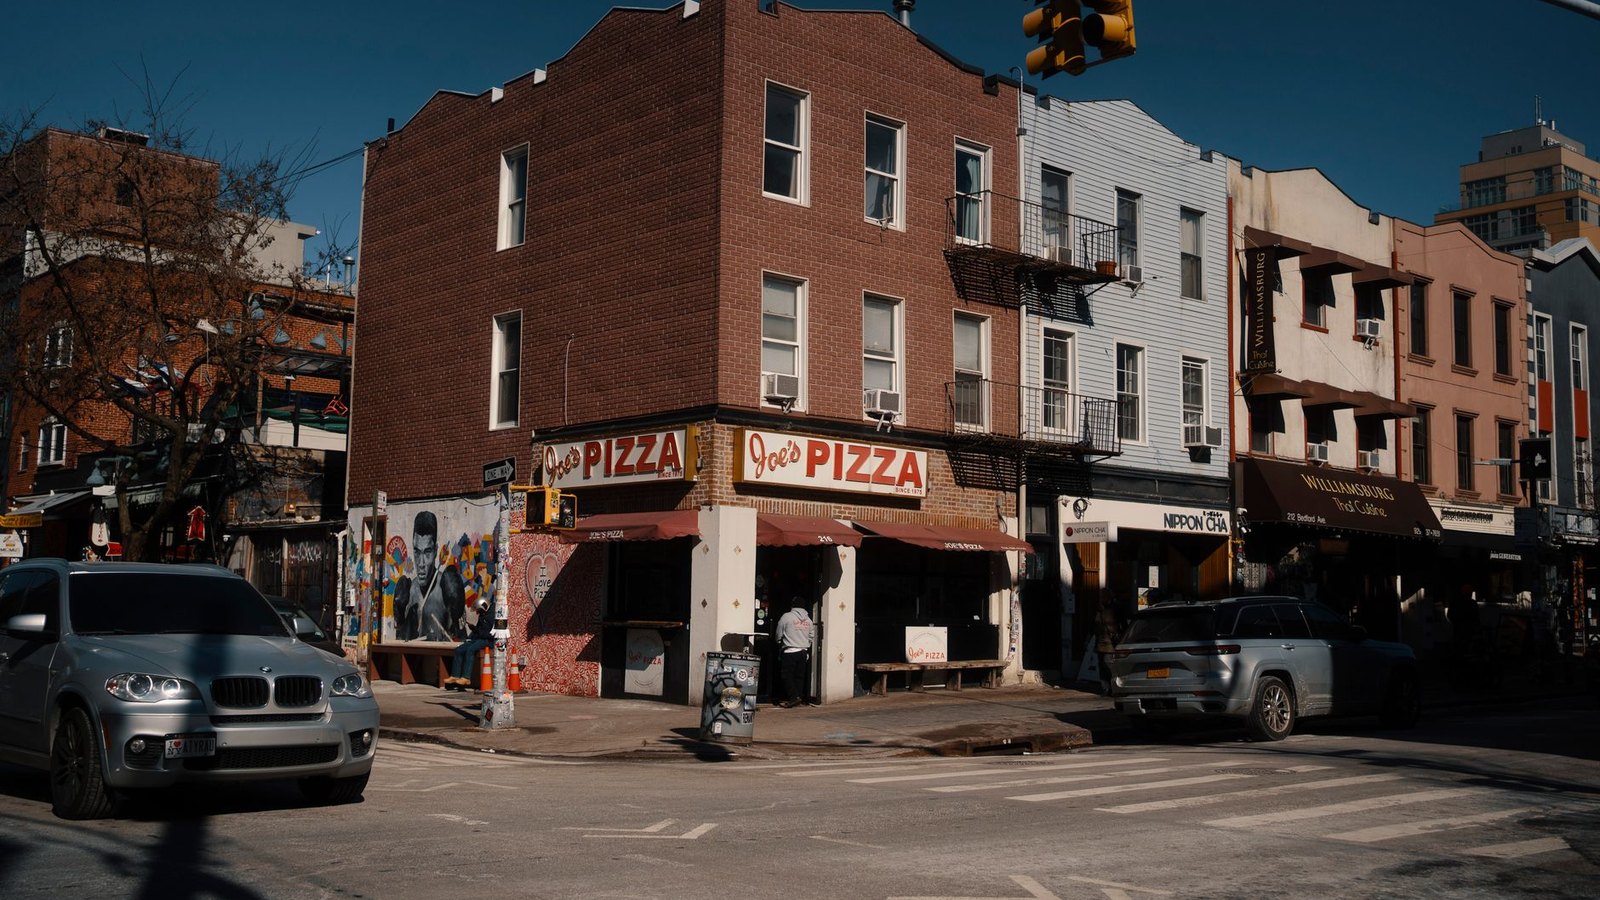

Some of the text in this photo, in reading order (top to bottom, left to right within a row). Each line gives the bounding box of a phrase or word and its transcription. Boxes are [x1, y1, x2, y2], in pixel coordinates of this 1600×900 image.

[1254, 252, 1266, 347] WILLIAMSBURG
[545, 432, 682, 487] Joe's PIZZA
[749, 433, 922, 488] Joe's PIZZA
[486, 469, 497, 479] ONE
[1301, 474, 1395, 500] WILLIAMSBURG
[1332, 497, 1388, 517] Thai Cuisine
[1164, 512, 1228, 533] NIPPON CHA
[1287, 512, 1295, 521] 212
[1297, 513, 1316, 523] Bedford
[607, 530, 624, 538] PIZZA
[1074, 527, 1094, 535] NIPPON
[540, 566, 546, 577] I
[535, 575, 552, 587] Love
[909, 646, 924, 659] Joe's
